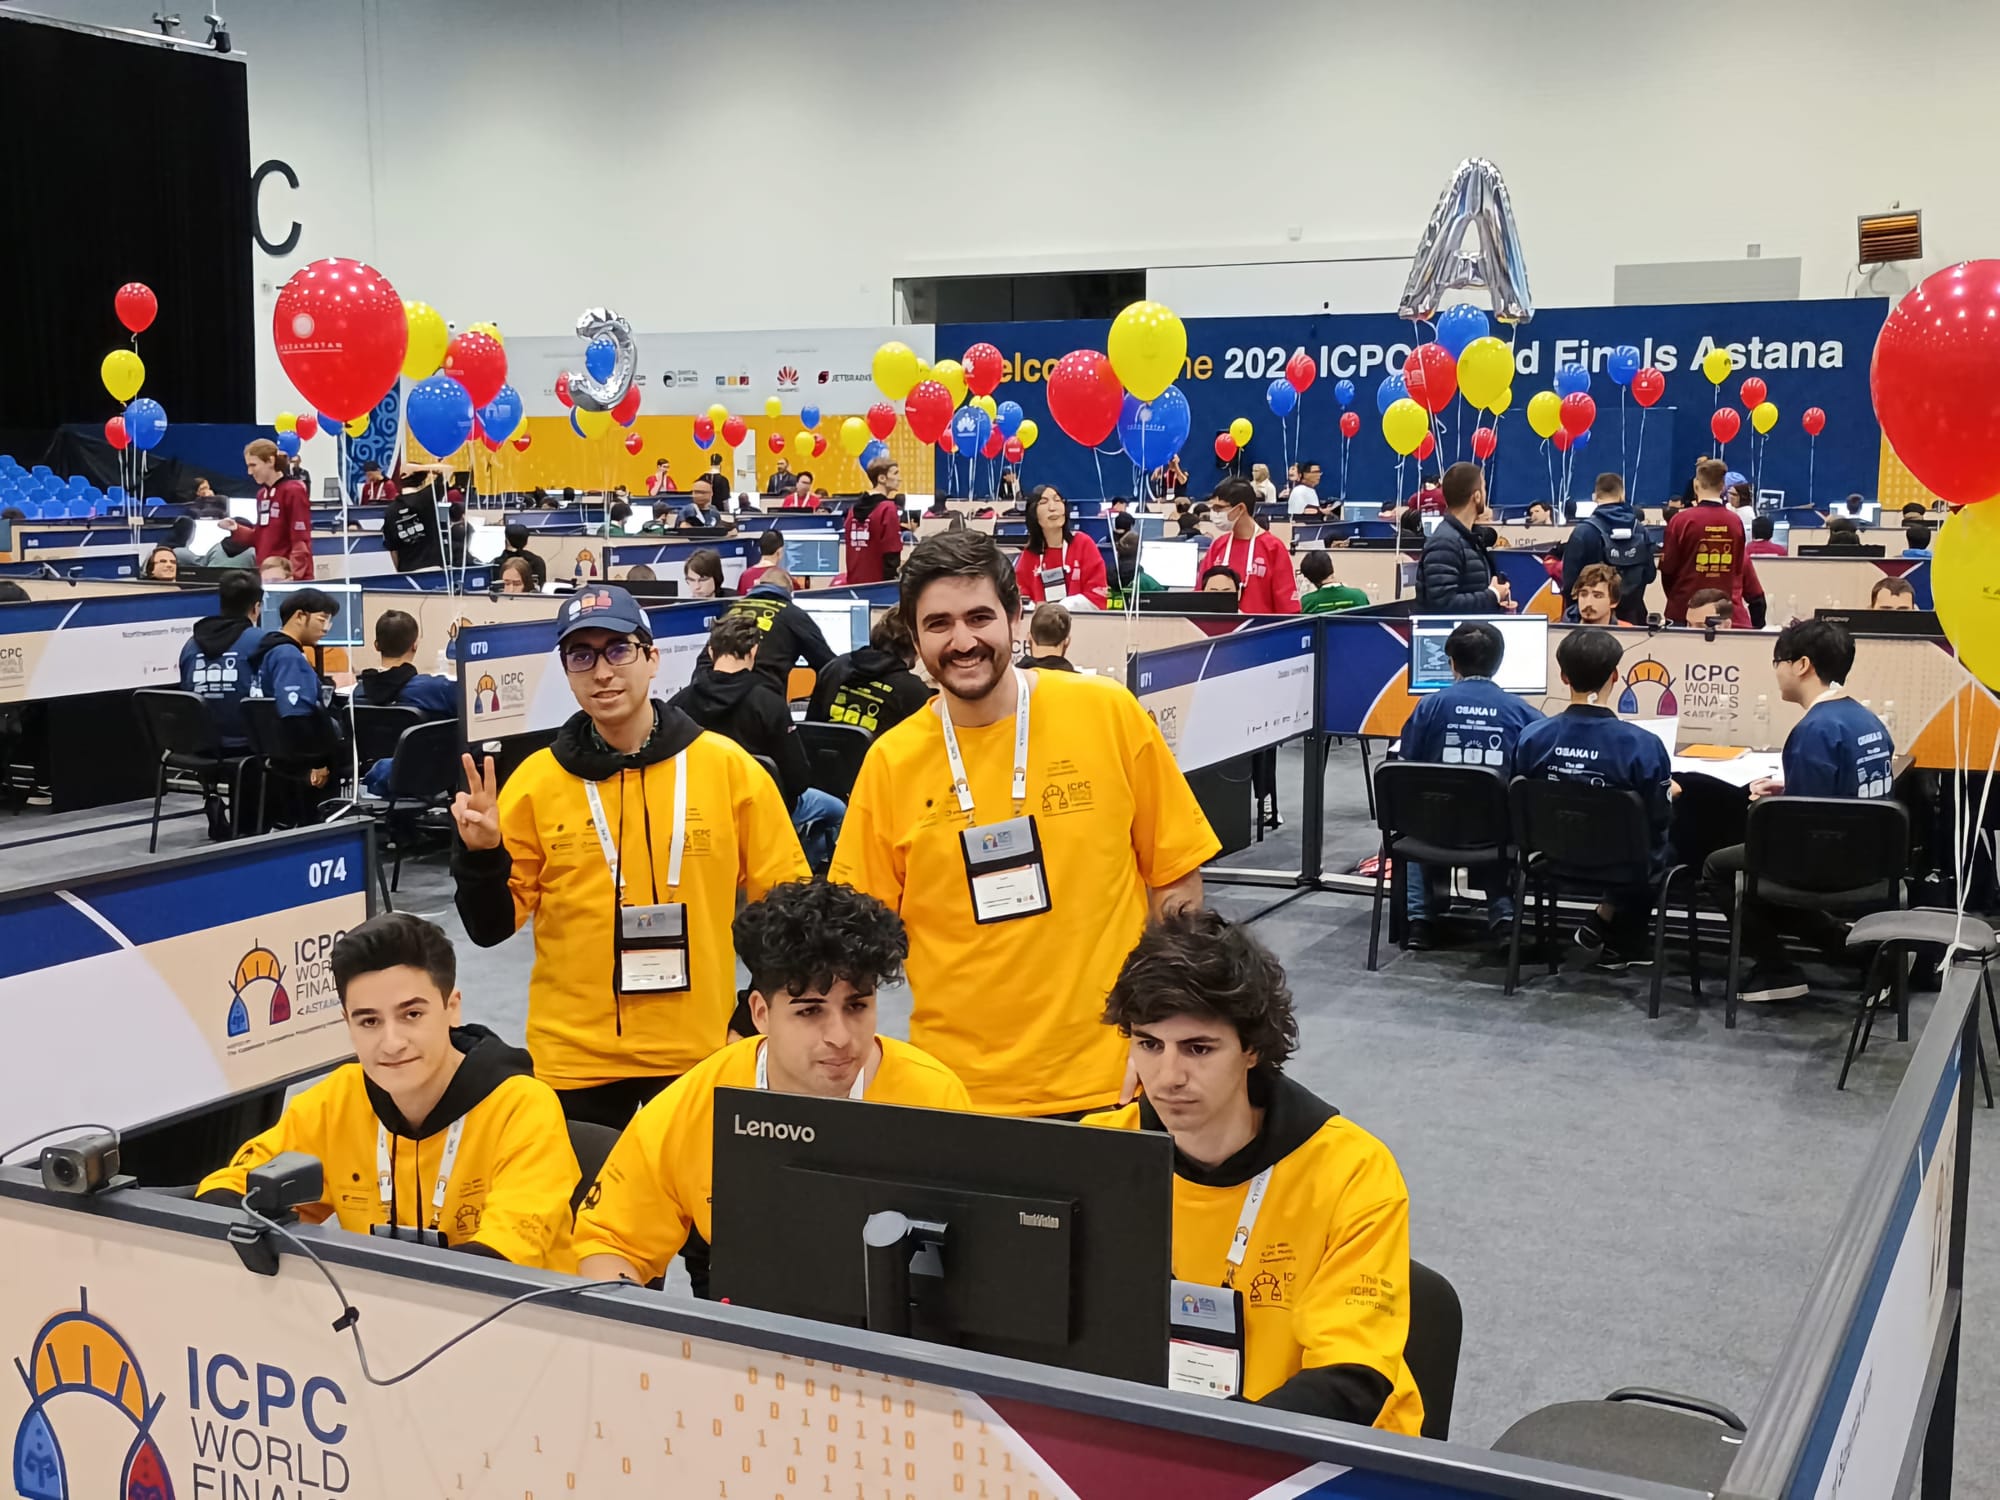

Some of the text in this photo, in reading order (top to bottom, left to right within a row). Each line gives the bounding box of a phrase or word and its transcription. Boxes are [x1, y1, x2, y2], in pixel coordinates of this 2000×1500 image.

[253, 159, 302, 257] C
[1224, 347, 1305, 380] 202
[1554, 338, 1678, 374] Finls
[0, 647, 23, 659] CPC
[501, 671, 525, 686] ICPC
[1684, 663, 1740, 683] ICPC
[1683, 694, 1739, 709] FINAS
[1684, 681, 1740, 696] WORLD
[308, 856, 348, 888] 074
[295, 960, 336, 983] WOR
[295, 978, 339, 1001] FINAL
[733, 1114, 816, 1144] Lenovo
[187, 1346, 348, 1445] ICPC
[191, 1416, 350, 1493] WORLD
[193, 1462, 337, 1500] FIN
